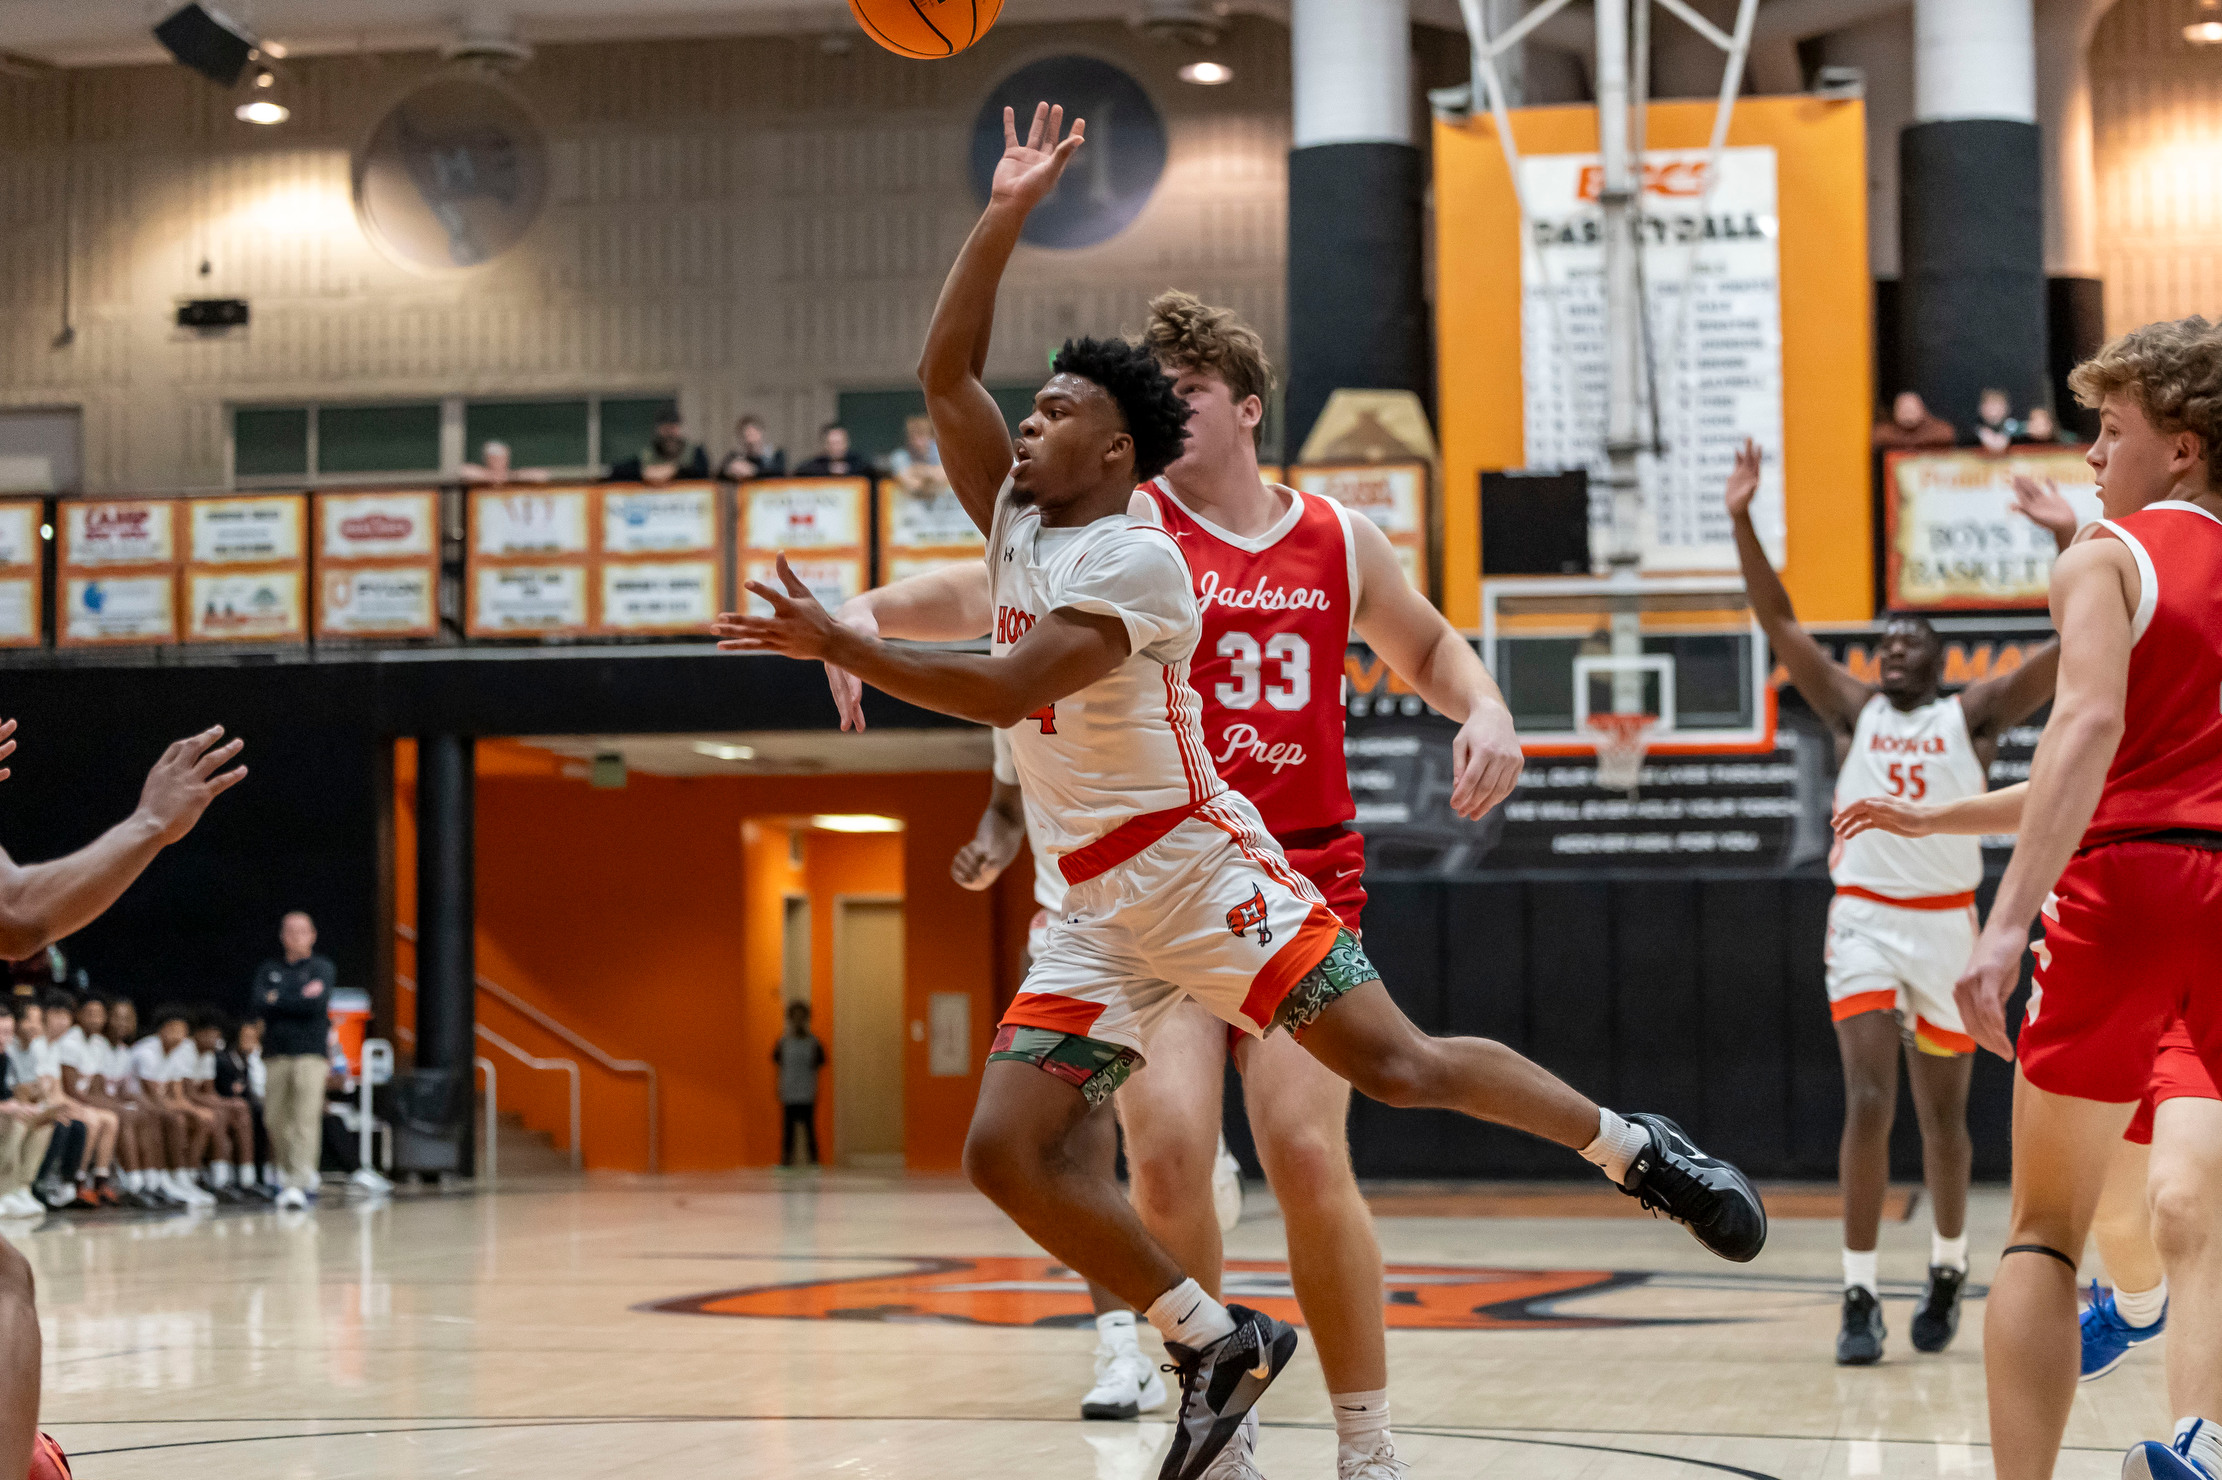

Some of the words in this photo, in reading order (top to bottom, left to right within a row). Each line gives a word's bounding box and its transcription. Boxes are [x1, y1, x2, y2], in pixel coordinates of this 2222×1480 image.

[1197, 570, 1331, 614] Jackson
[1908, 556, 2049, 588] BASKET
[1215, 630, 1311, 711] 33
[1215, 723, 1307, 775] Prep
[1886, 762, 1927, 801] 55
[1239, 902, 1262, 926] H
